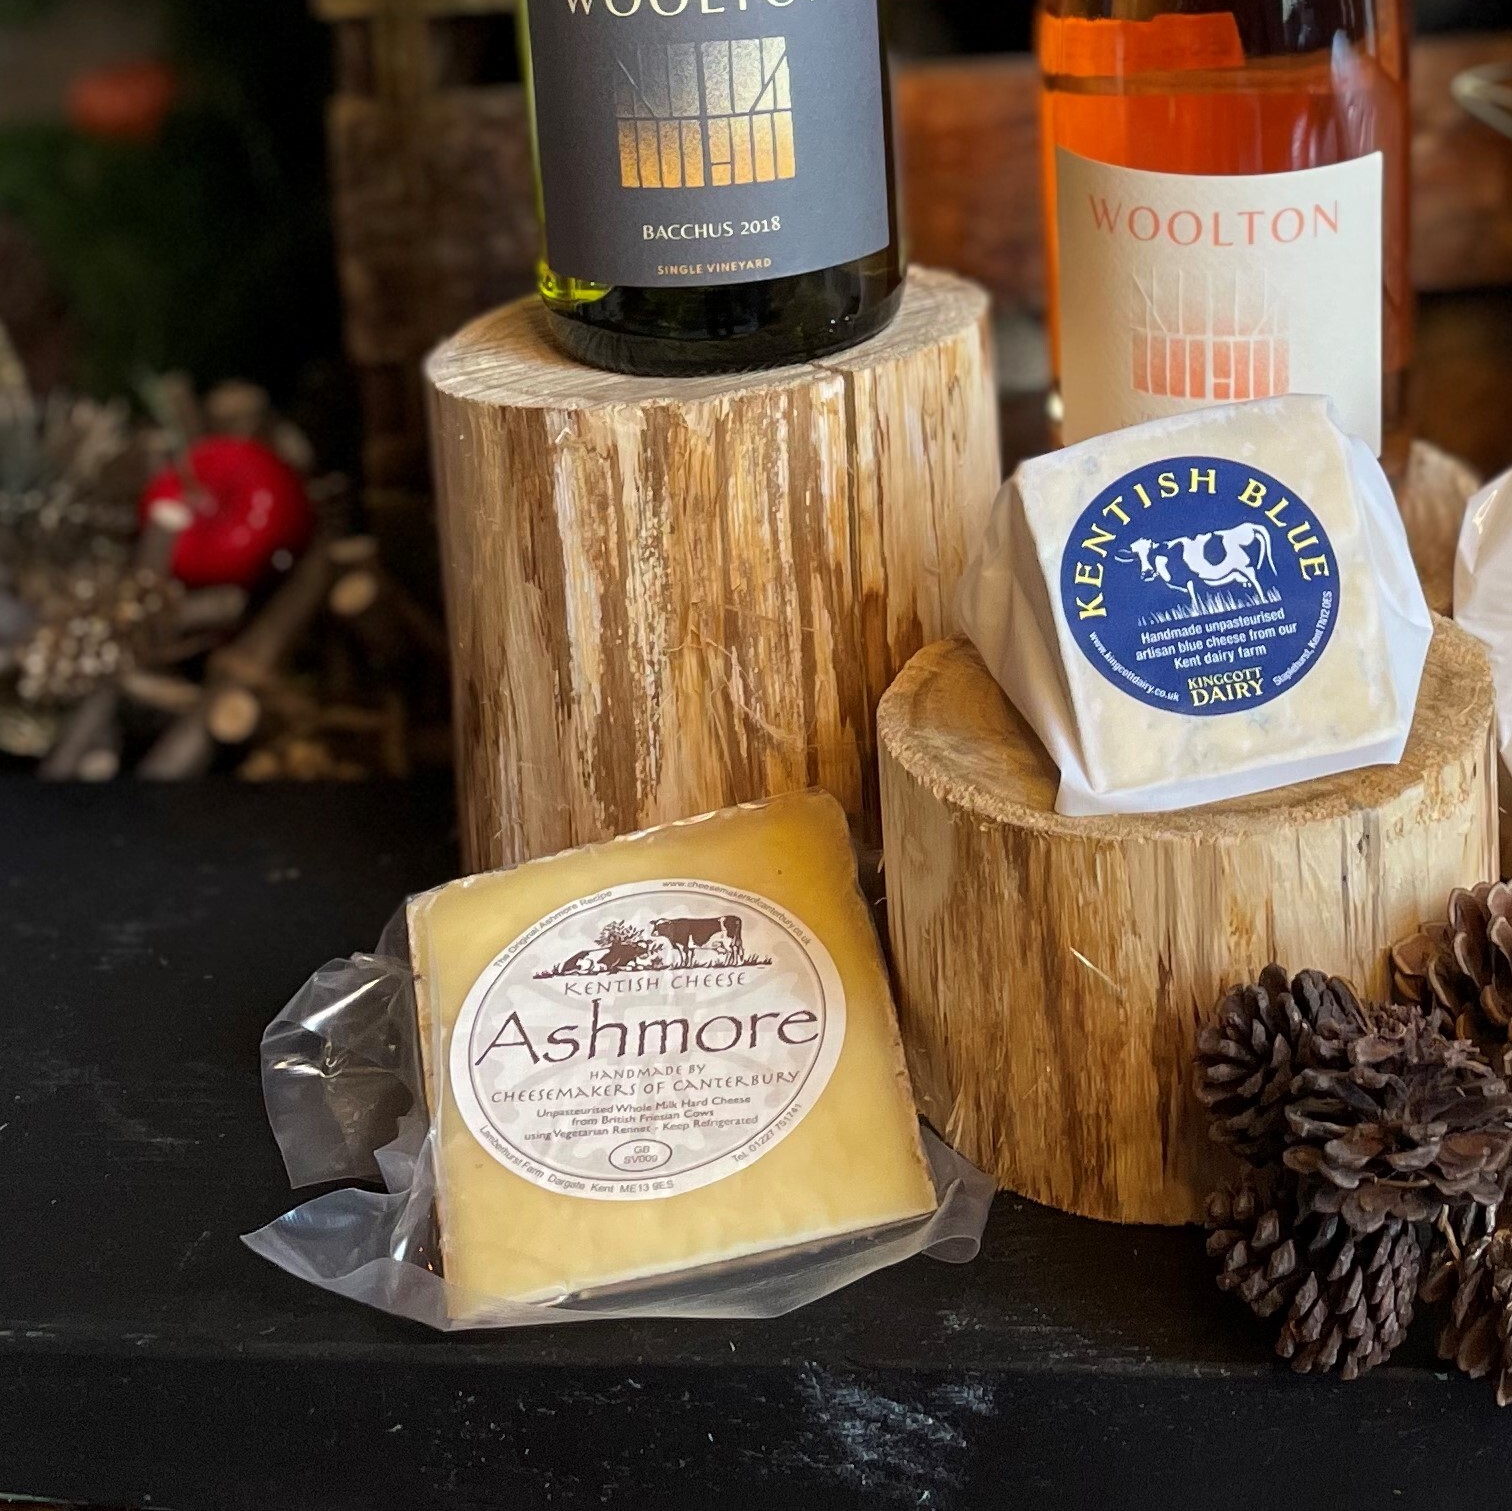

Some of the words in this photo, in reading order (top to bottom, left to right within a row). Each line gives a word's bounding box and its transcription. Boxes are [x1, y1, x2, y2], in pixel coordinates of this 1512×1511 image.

[642, 220, 734, 241] BACCHUS
[740, 216, 781, 236] 2018
[1089, 194, 1339, 247] WOOLTON
[657, 262, 703, 276] SINGLE
[707, 257, 772, 273] VINEYARD
[1075, 468, 1217, 620] KENTISH
[1238, 478, 1330, 581] BLUE
[1141, 623, 1203, 645] Handmade
[1205, 607, 1285, 633] unpasteurised
[1135, 645, 1176, 661] artisan
[1177, 639, 1203, 653] blue
[1206, 632, 1247, 649] cheese
[1249, 627, 1277, 639] from
[1278, 622, 1298, 635] our
[1089, 631, 1180, 702] www.kingcottdairy.co.uk
[1174, 654, 1202, 670] Kent
[1204, 648, 1235, 664] dairy
[1238, 644, 1267, 659] farm
[1187, 666, 1263, 689] KINGCOTT
[1190, 678, 1265, 707] DAIRY
[493, 953, 509, 969] The
[508, 927, 540, 954] Original
[539, 903, 579, 930] Ashmore
[579, 890, 612, 907] Recipe
[565, 977, 660, 996] KENTISH
[671, 971, 746, 989] CHEESE
[475, 998, 819, 1068] Ashmore
[491, 1083, 637, 1103] CHEESEMAKERS
[643, 1081, 666, 1095] OF
[673, 1070, 801, 1092] CANTERBURY
[589, 1065, 682, 1081] HANDMADE
[688, 1063, 706, 1074] BY
[536, 1105, 614, 1119] Unpasteurised
[616, 1102, 652, 1114] Whole
[655, 1101, 677, 1111] Milk
[681, 1097, 709, 1108] Hard
[711, 1096, 751, 1106] Cheese
[571, 1117, 598, 1126] from
[601, 1113, 636, 1125] British
[639, 1112, 680, 1123] Friesian
[684, 1108, 714, 1119] Cows
[524, 1131, 552, 1141] using
[553, 1128, 609, 1140] Vegetarian
[612, 1125, 651, 1135] Rennet
[662, 1122, 690, 1132] Keep
[693, 1115, 758, 1128] Refrigerated
[521, 1160, 545, 1178] Farm
[547, 1173, 586, 1190] Dargate
[590, 1183, 615, 1193] Kent
[619, 1182, 650, 1194] ME13
